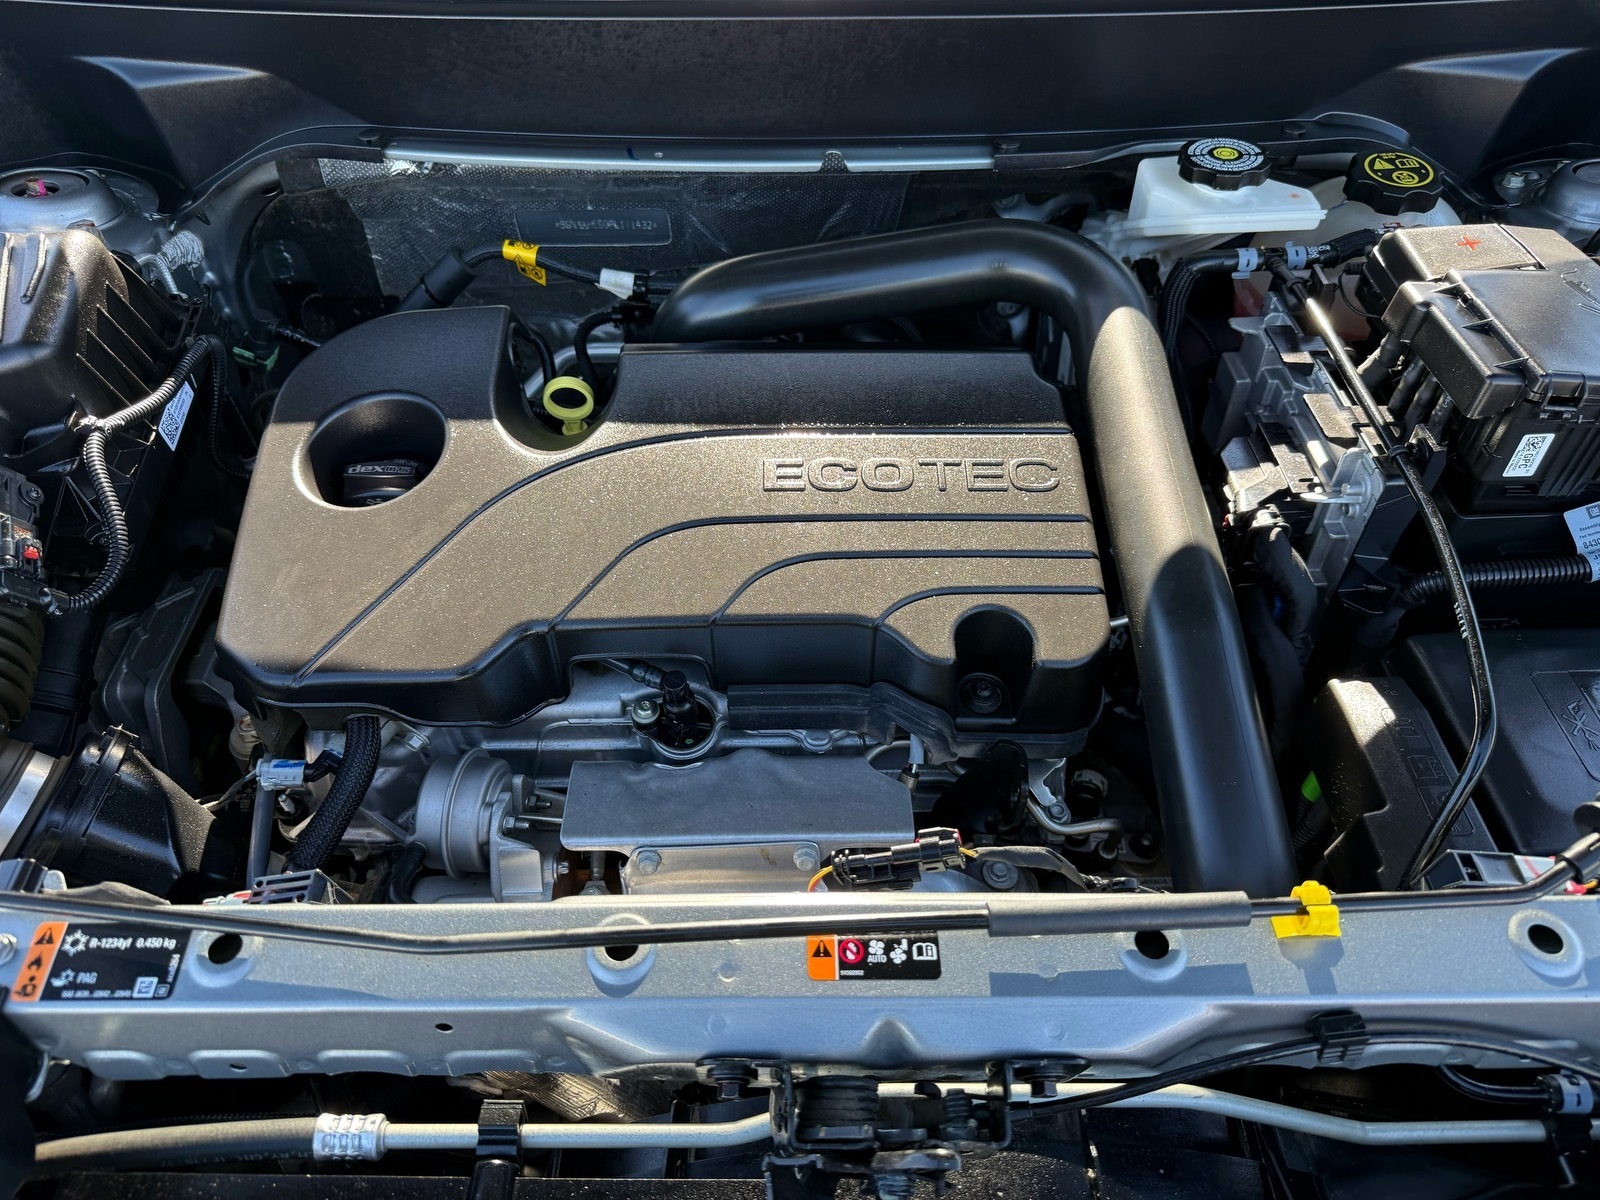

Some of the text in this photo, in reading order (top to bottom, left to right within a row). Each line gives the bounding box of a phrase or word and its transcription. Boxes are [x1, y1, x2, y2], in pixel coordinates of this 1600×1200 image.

[1518, 453, 1534, 469] GPC
[763, 458, 1060, 492] ECOTEC
[89, 936, 177, 950] R-1234yf 0.450 kg
[867, 954, 887, 963] AUTO
[76, 972, 98, 984] PAG
